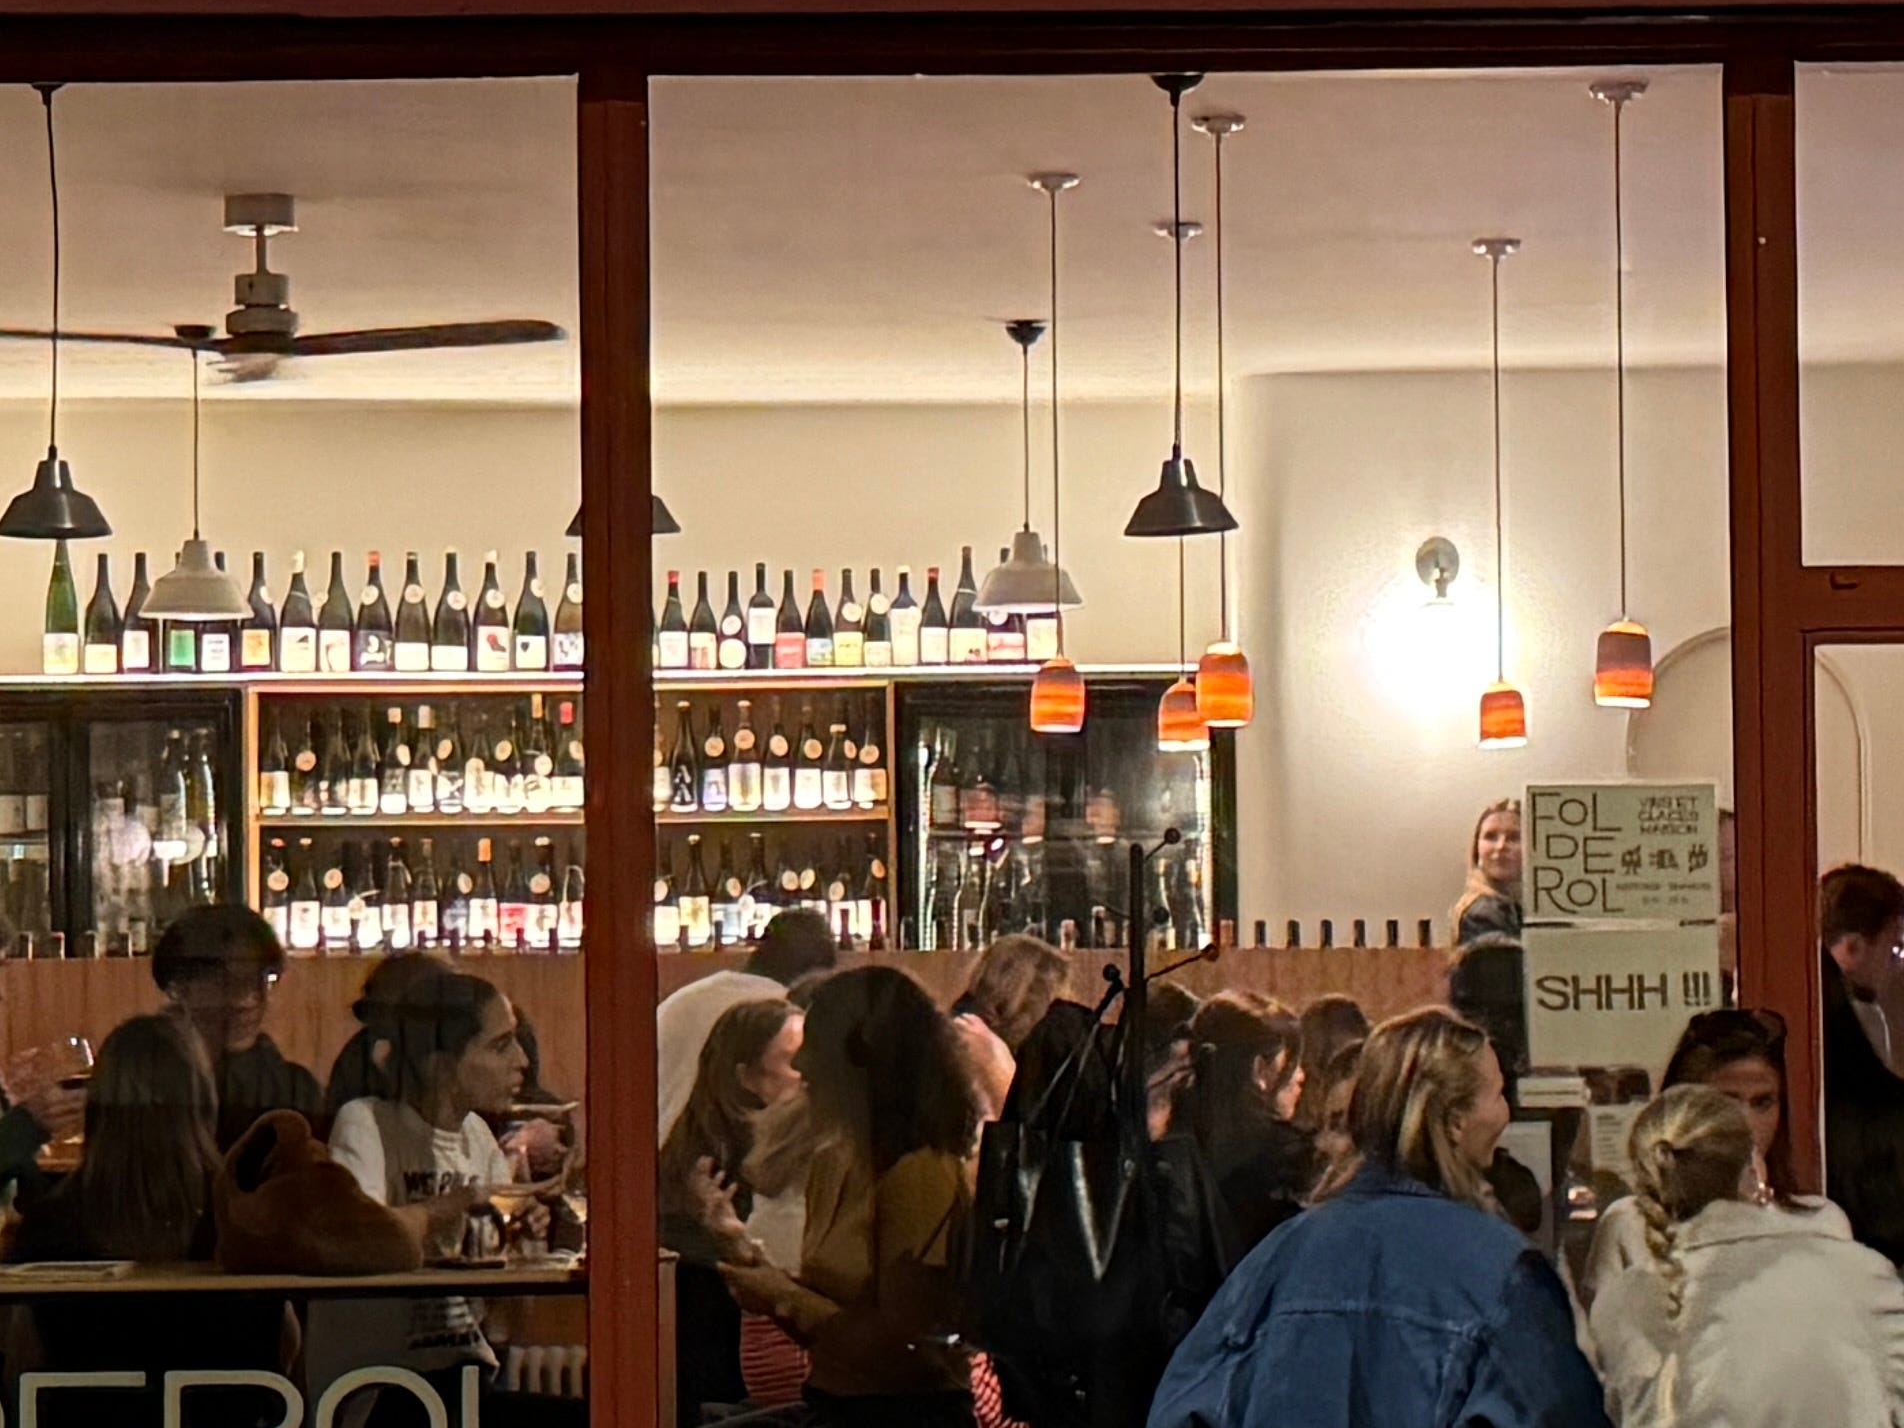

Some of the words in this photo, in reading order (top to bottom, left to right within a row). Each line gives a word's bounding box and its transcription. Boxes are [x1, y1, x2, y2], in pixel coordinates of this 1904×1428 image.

[1532, 792, 1622, 851] FOL
[1546, 834, 1616, 874] DE
[1534, 866, 1625, 914] ROL
[1536, 973, 1668, 1011] SHHH
